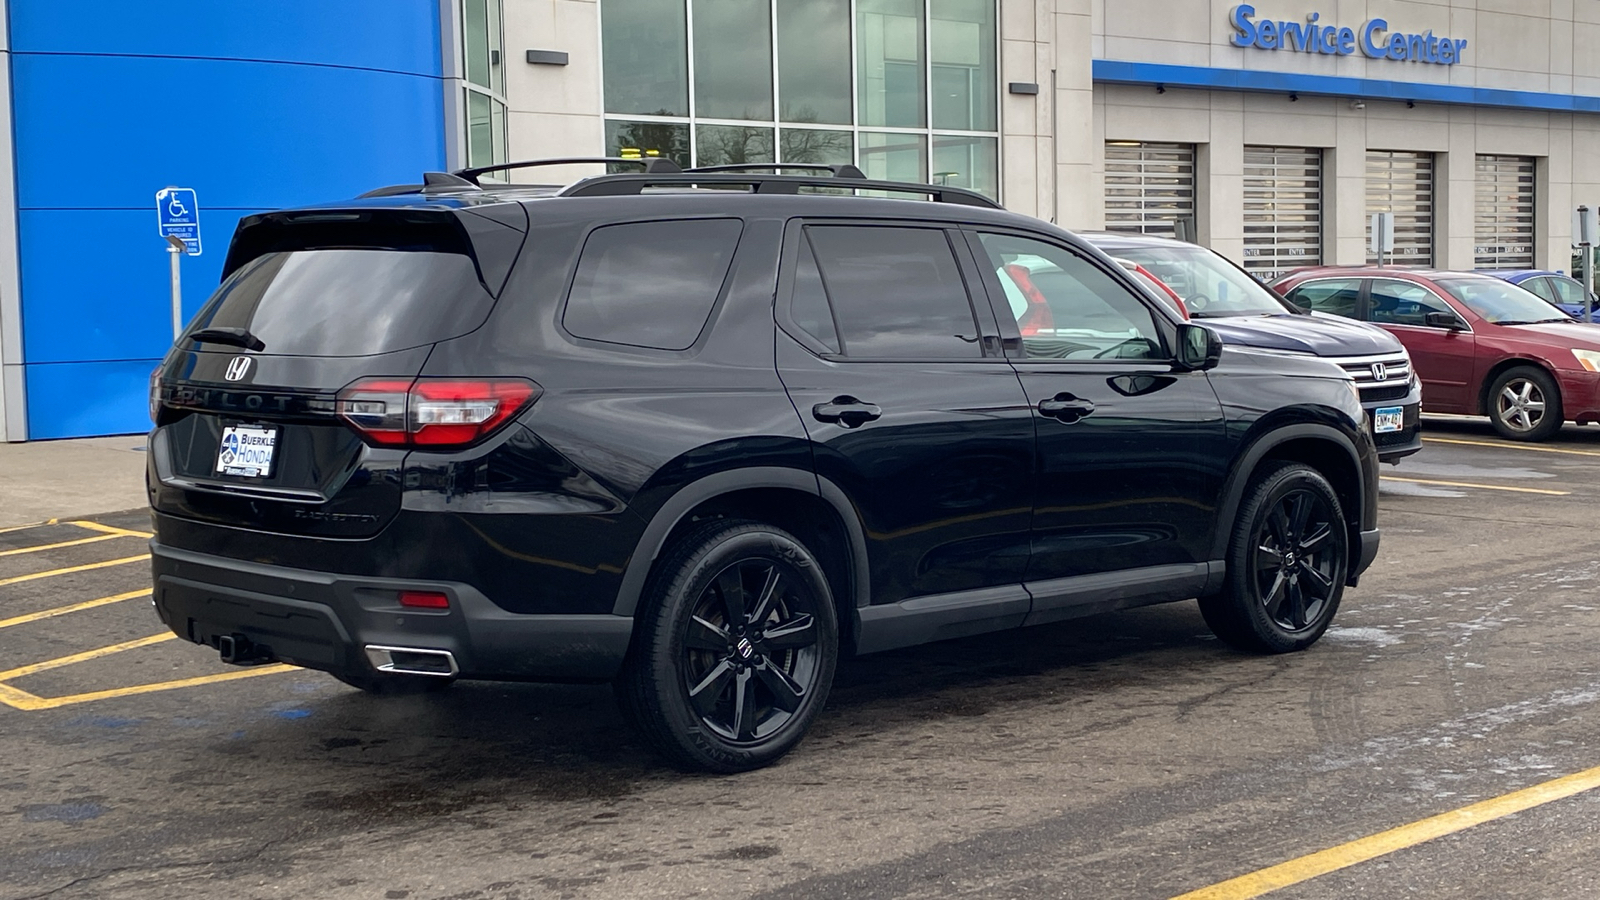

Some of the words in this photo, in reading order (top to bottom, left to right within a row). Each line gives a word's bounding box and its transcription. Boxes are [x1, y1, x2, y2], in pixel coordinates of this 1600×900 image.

[1229, 3, 1355, 56] Service
[1359, 18, 1467, 65] Center
[1243, 248, 1260, 256] ENTER
[1403, 247, 1419, 255] ENTER
[237, 445, 272, 464] HONDA
